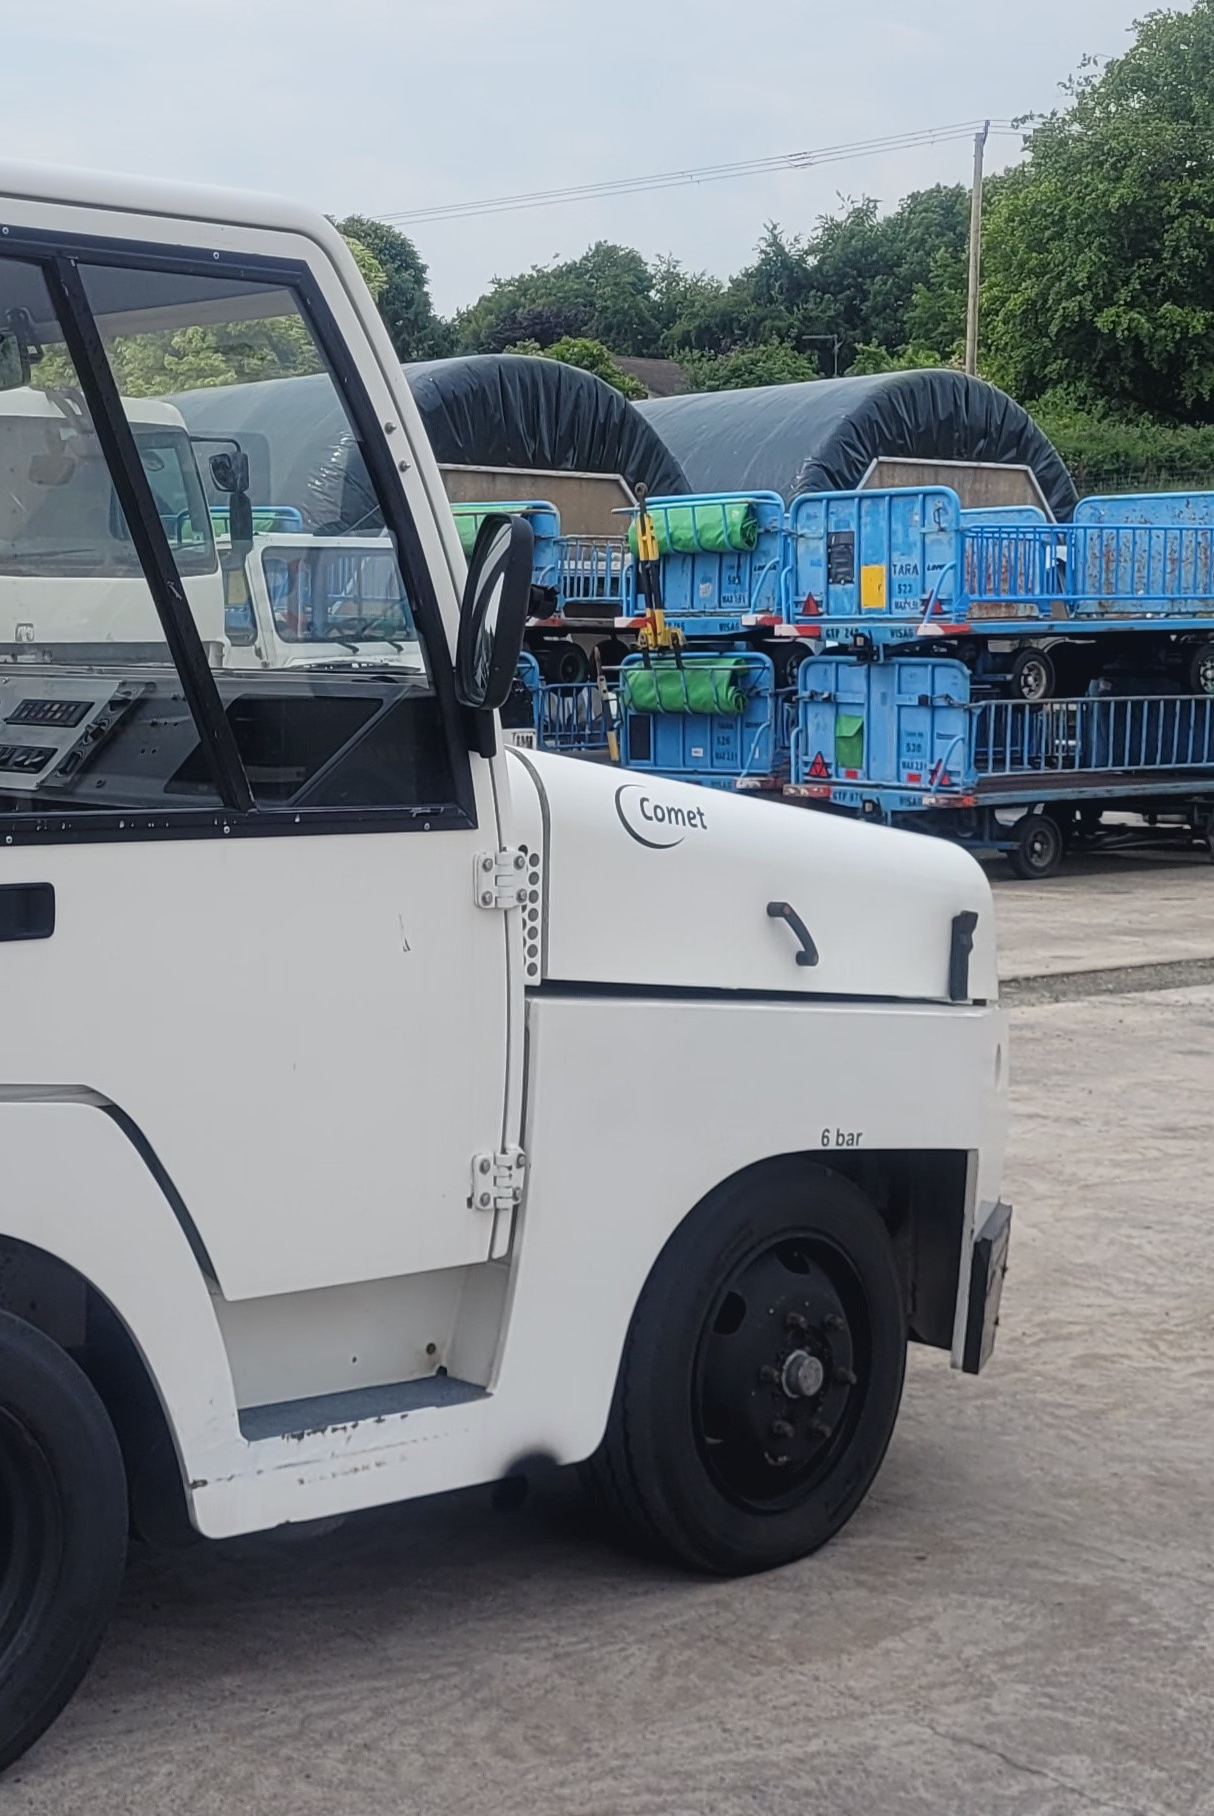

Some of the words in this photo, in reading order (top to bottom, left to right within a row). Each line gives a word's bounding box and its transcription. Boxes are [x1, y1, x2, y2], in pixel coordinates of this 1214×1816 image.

[892, 563, 920, 576] TARA
[890, 628, 915, 640] VISAG
[639, 796, 708, 830] Comet
[821, 1128, 830, 1147] 6
[836, 1127, 863, 1147] bar
